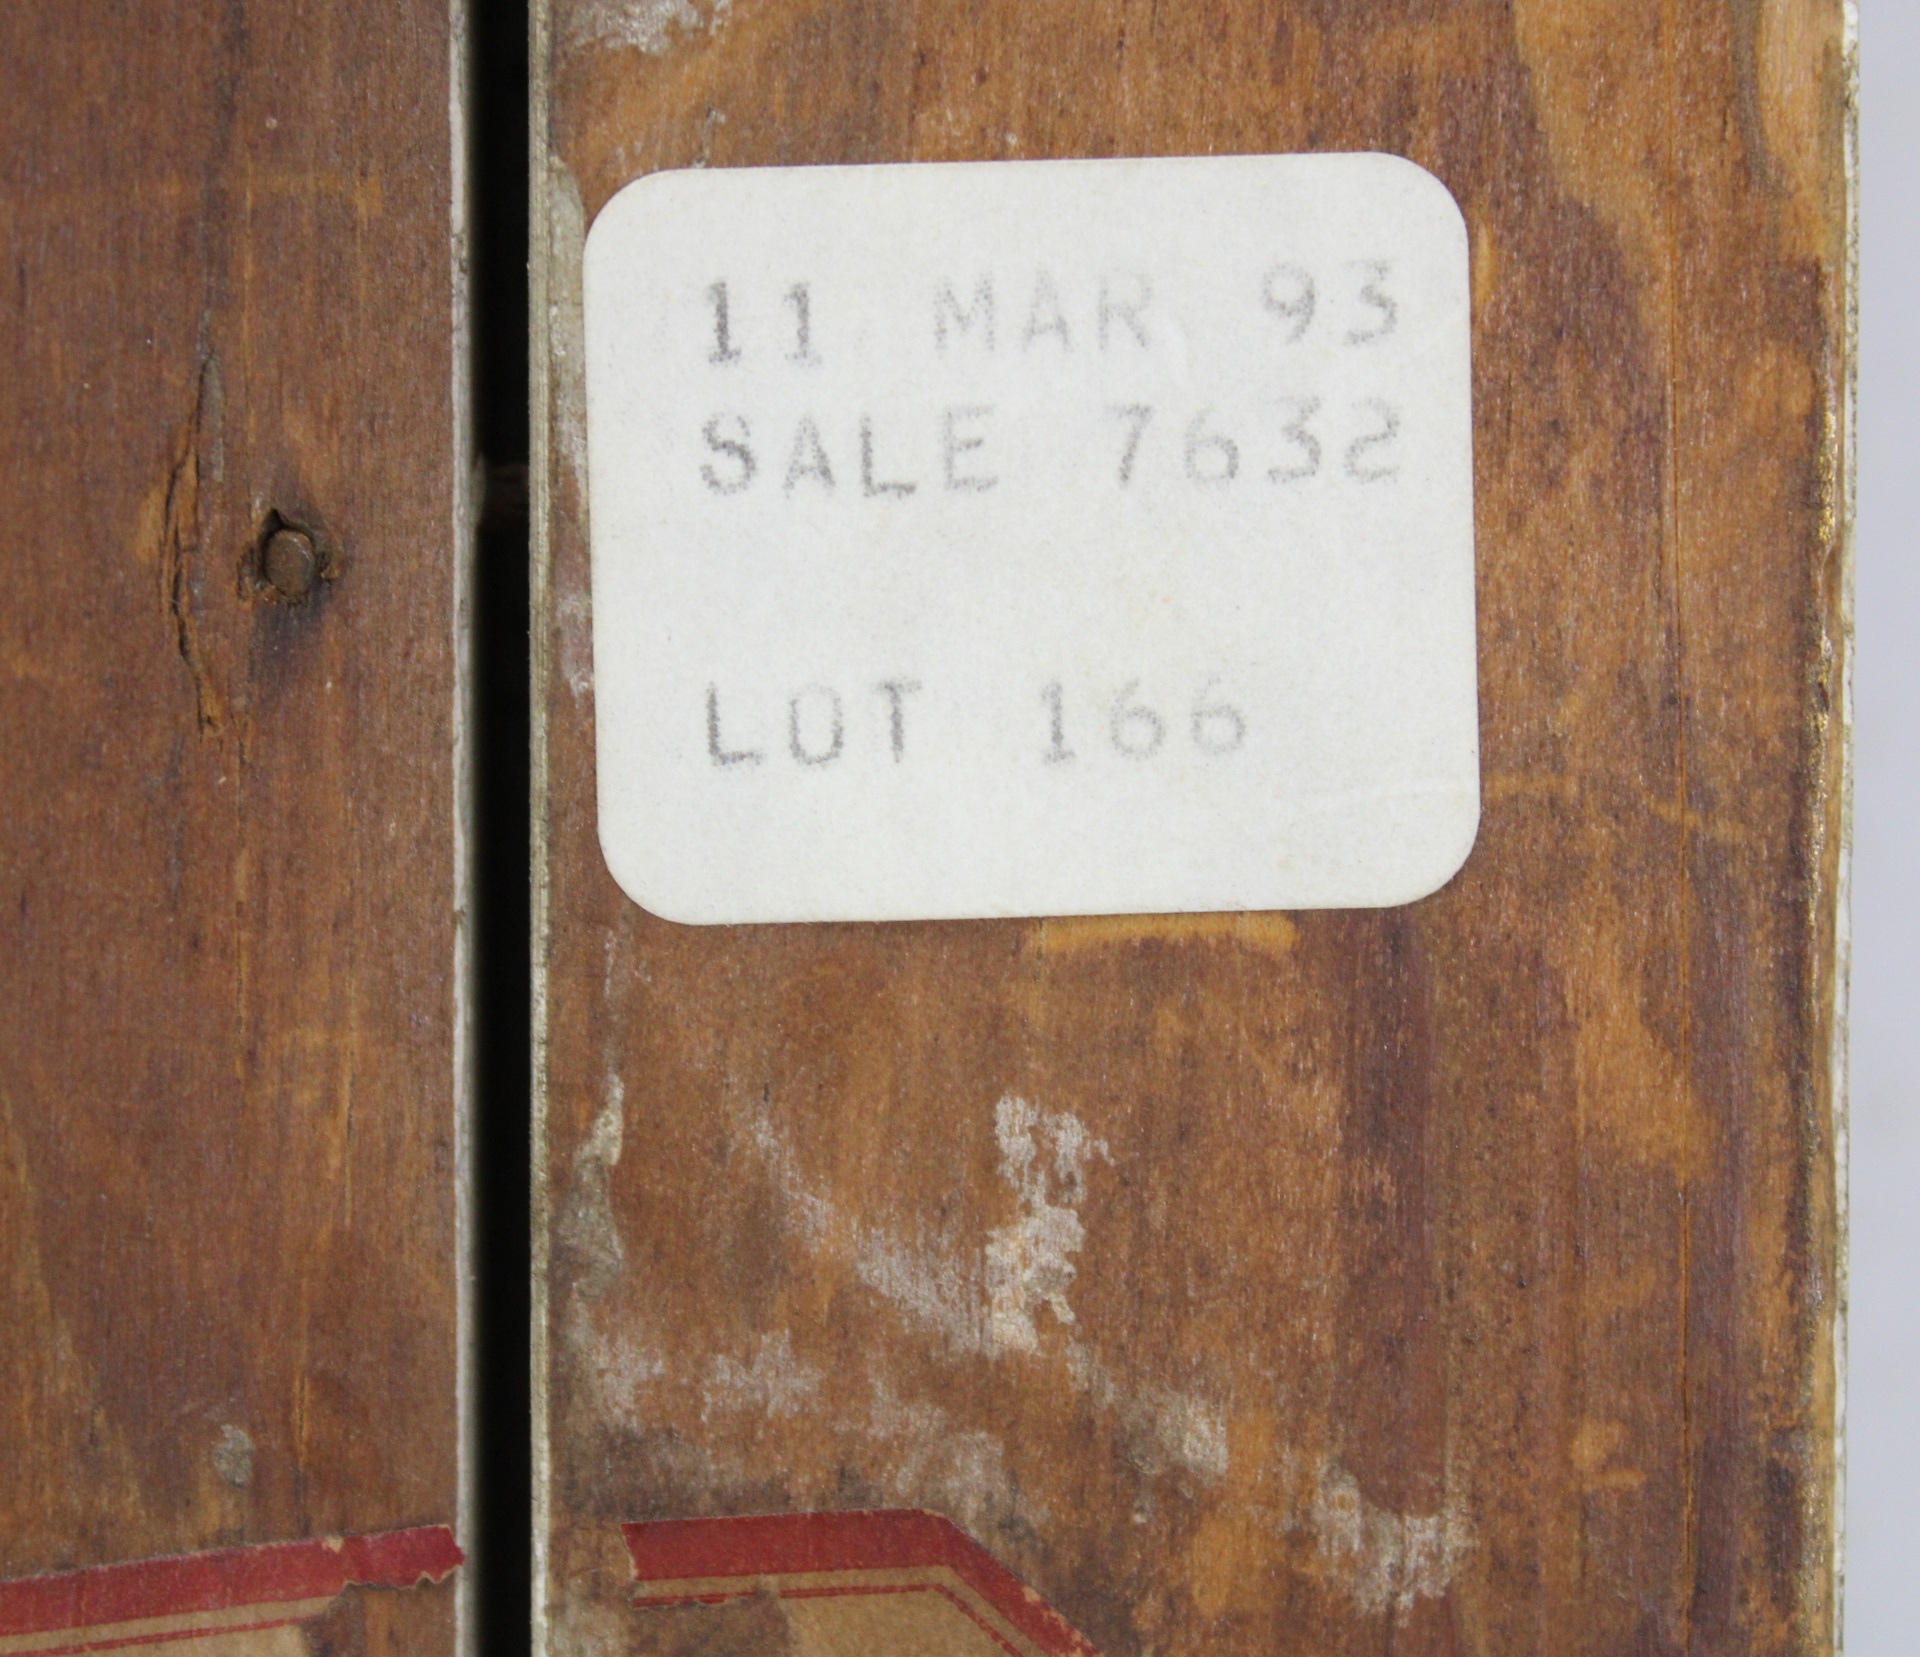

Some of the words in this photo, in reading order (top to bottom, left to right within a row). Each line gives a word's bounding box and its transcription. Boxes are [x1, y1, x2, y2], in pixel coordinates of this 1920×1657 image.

[702, 277, 820, 366] 11
[933, 264, 1154, 355] MAR
[1261, 258, 1401, 347] 93
[699, 406, 1000, 498] SALE
[1107, 395, 1403, 489] 7632
[706, 680, 921, 769] LOT
[1040, 679, 1248, 764] 166
